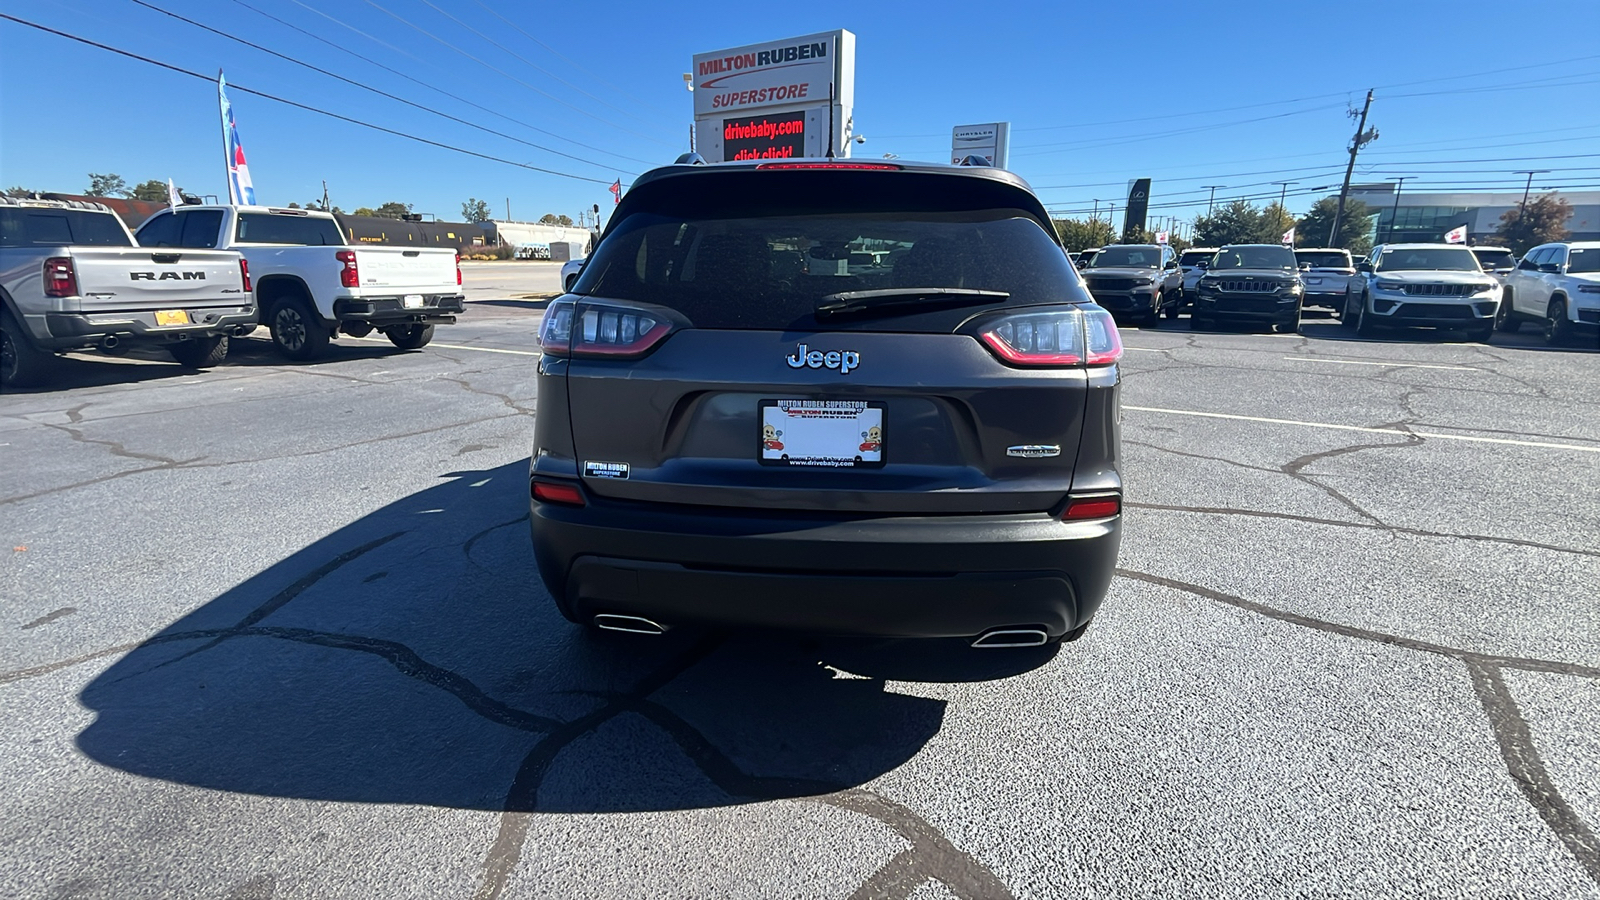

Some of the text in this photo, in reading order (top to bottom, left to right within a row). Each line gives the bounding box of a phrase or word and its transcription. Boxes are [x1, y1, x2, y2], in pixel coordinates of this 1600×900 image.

[699, 42, 827, 76] MILTON RUBEN
[712, 83, 809, 108] SUPERSTORE
[724, 120, 803, 140] drivebaby.com
[130, 272, 206, 281] RAM
[786, 344, 860, 374] Jeep
[778, 400, 868, 409] MILTON RUBEN SUPERSTORE
[586, 462, 627, 471] MILTON RUBEN
